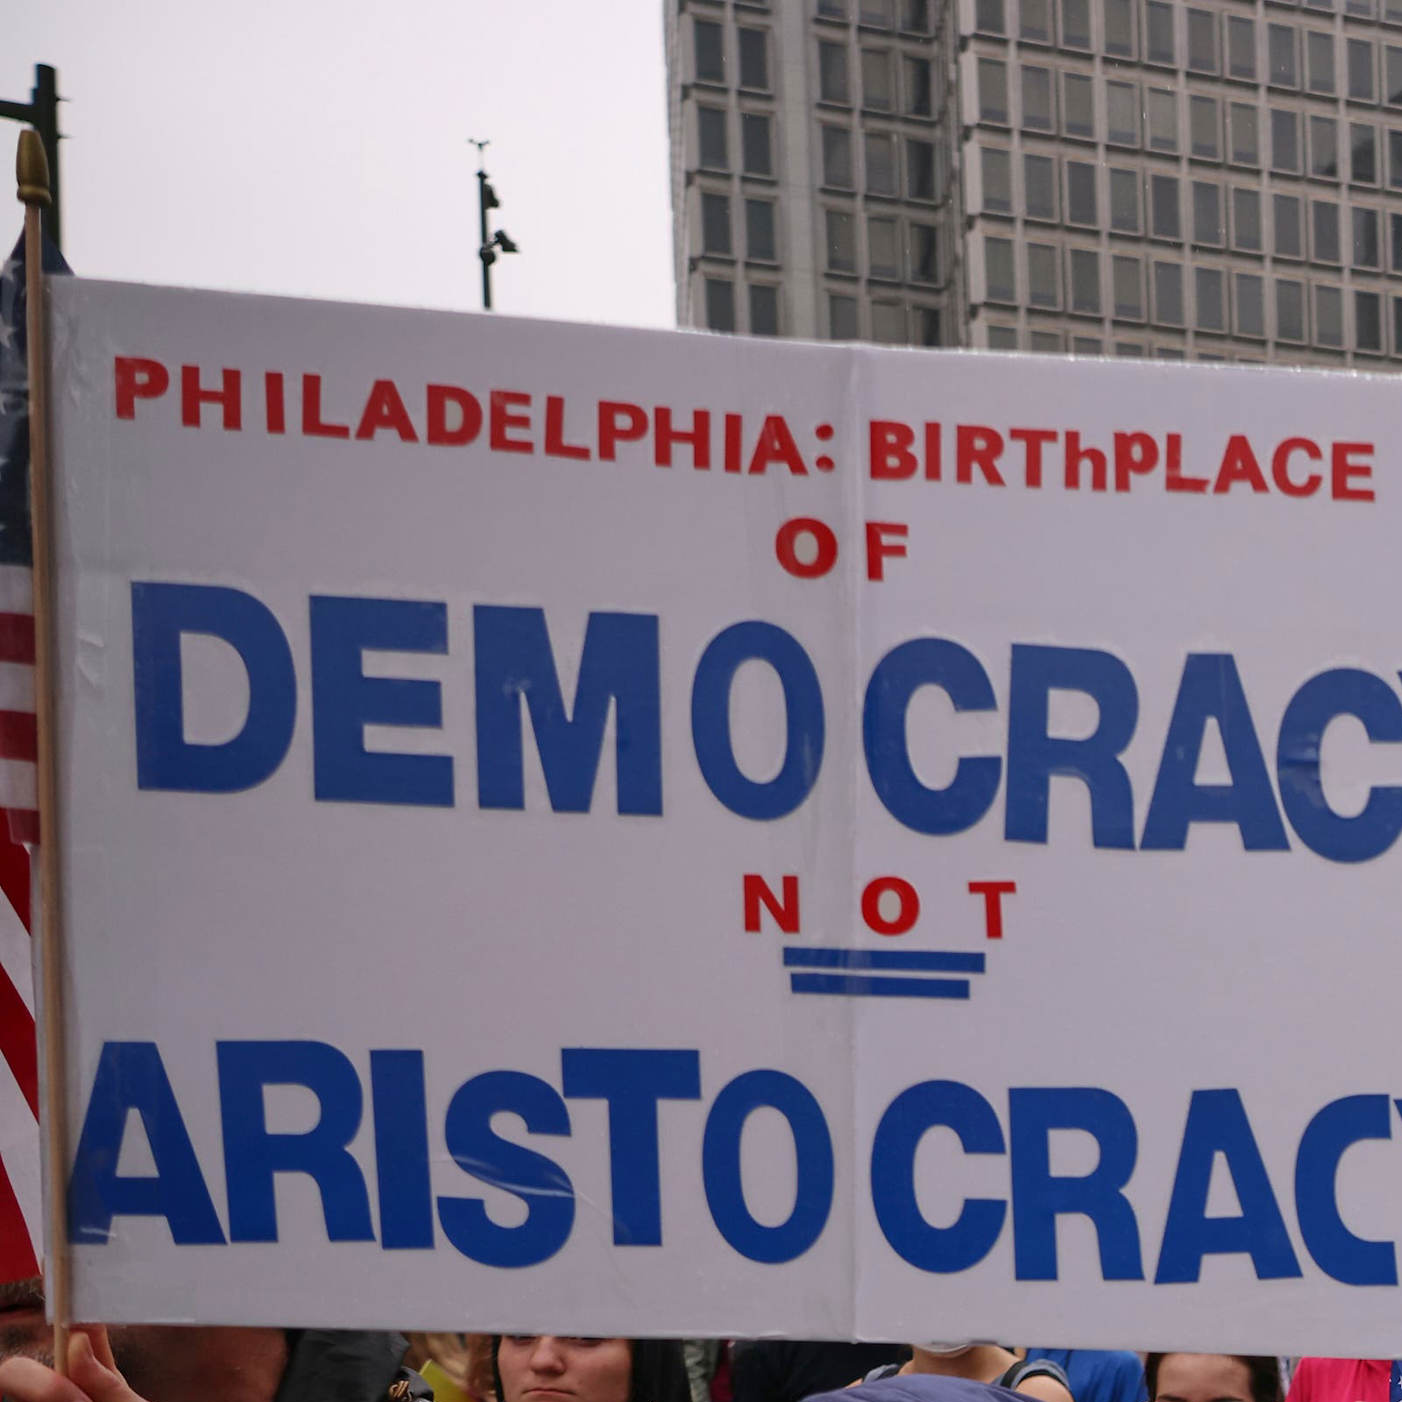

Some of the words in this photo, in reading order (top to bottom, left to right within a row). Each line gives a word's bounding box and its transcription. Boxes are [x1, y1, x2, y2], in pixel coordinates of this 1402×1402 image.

[113, 355, 836, 477] PHILADELPHIA:
[774, 516, 909, 582] OF
[741, 873, 1017, 940] NOT
